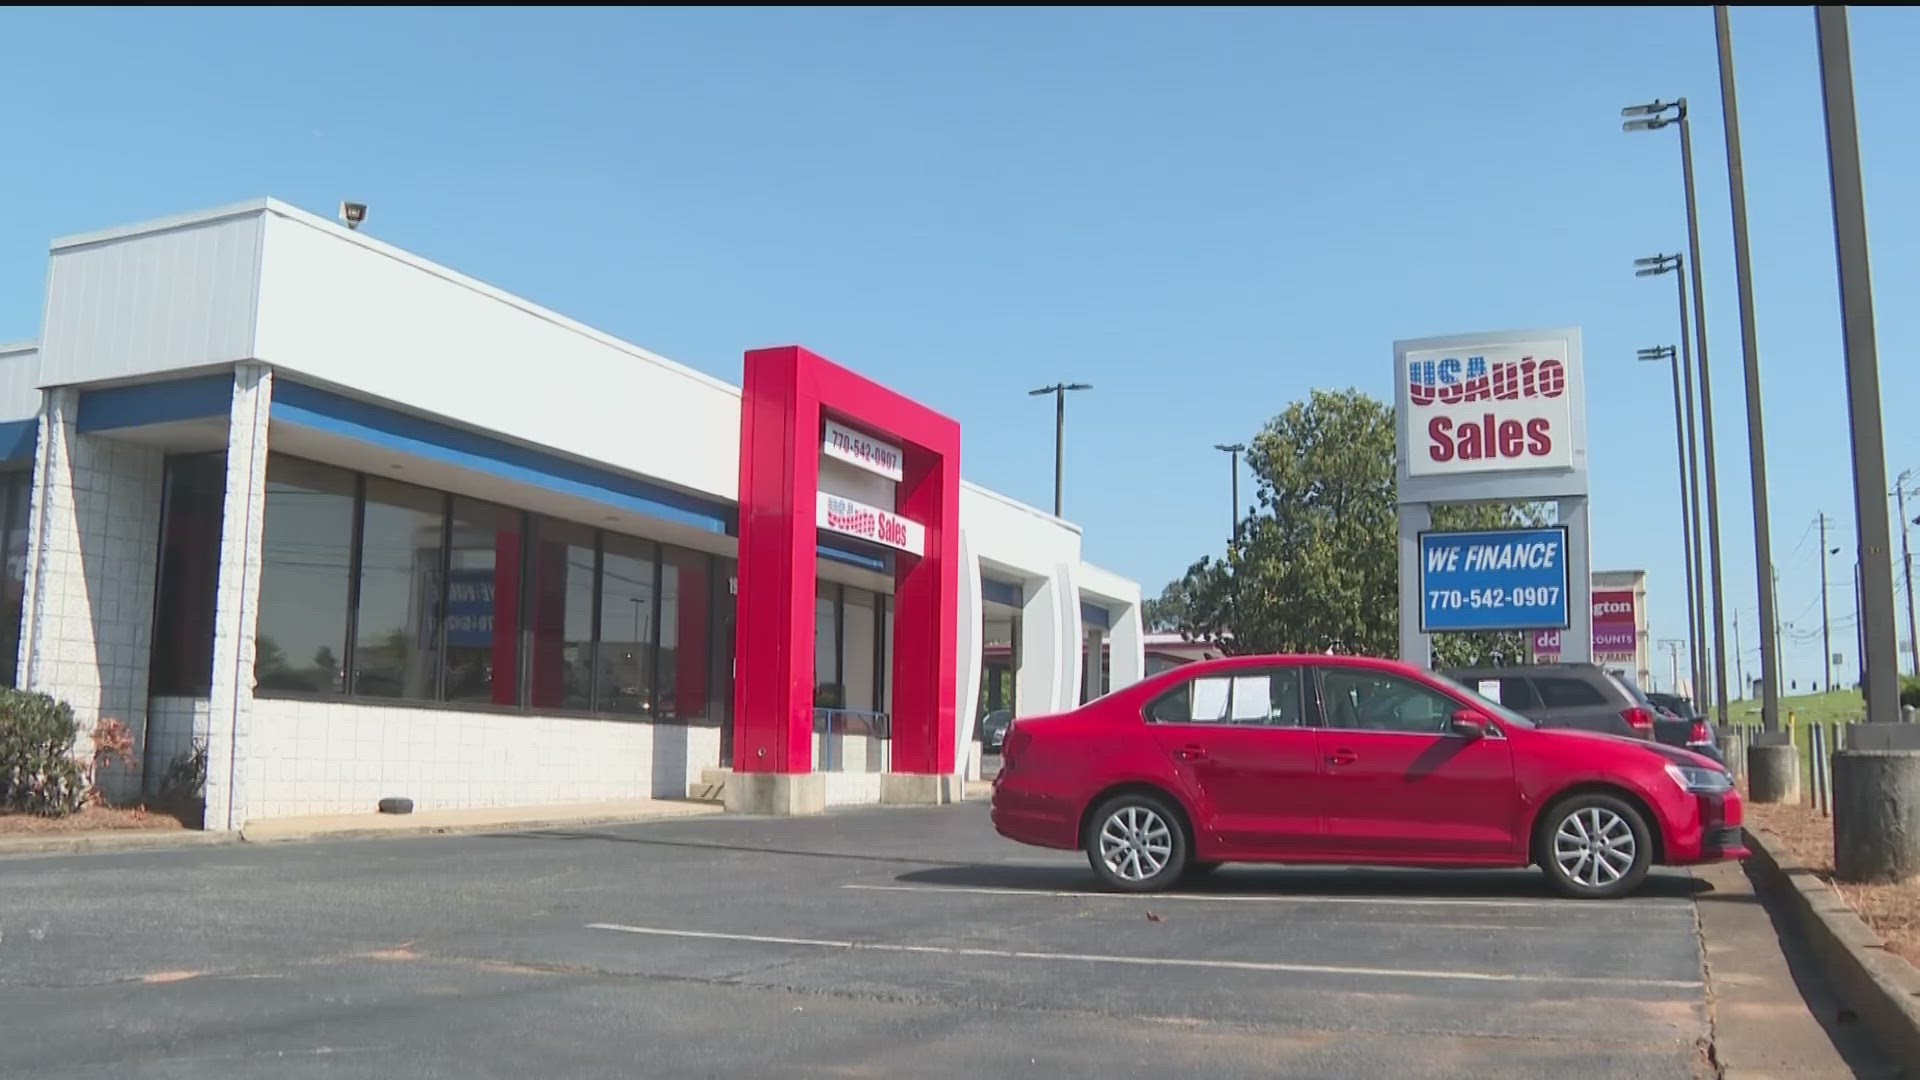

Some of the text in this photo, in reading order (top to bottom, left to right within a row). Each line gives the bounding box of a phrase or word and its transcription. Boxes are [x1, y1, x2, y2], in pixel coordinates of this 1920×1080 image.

[832, 430, 897, 471] 770-542-0907
[1428, 413, 1552, 462] Sales
[878, 511, 907, 547] Sales
[1428, 541, 1558, 572] WE FINANCE
[1429, 587, 1559, 609] 770-542-0907
